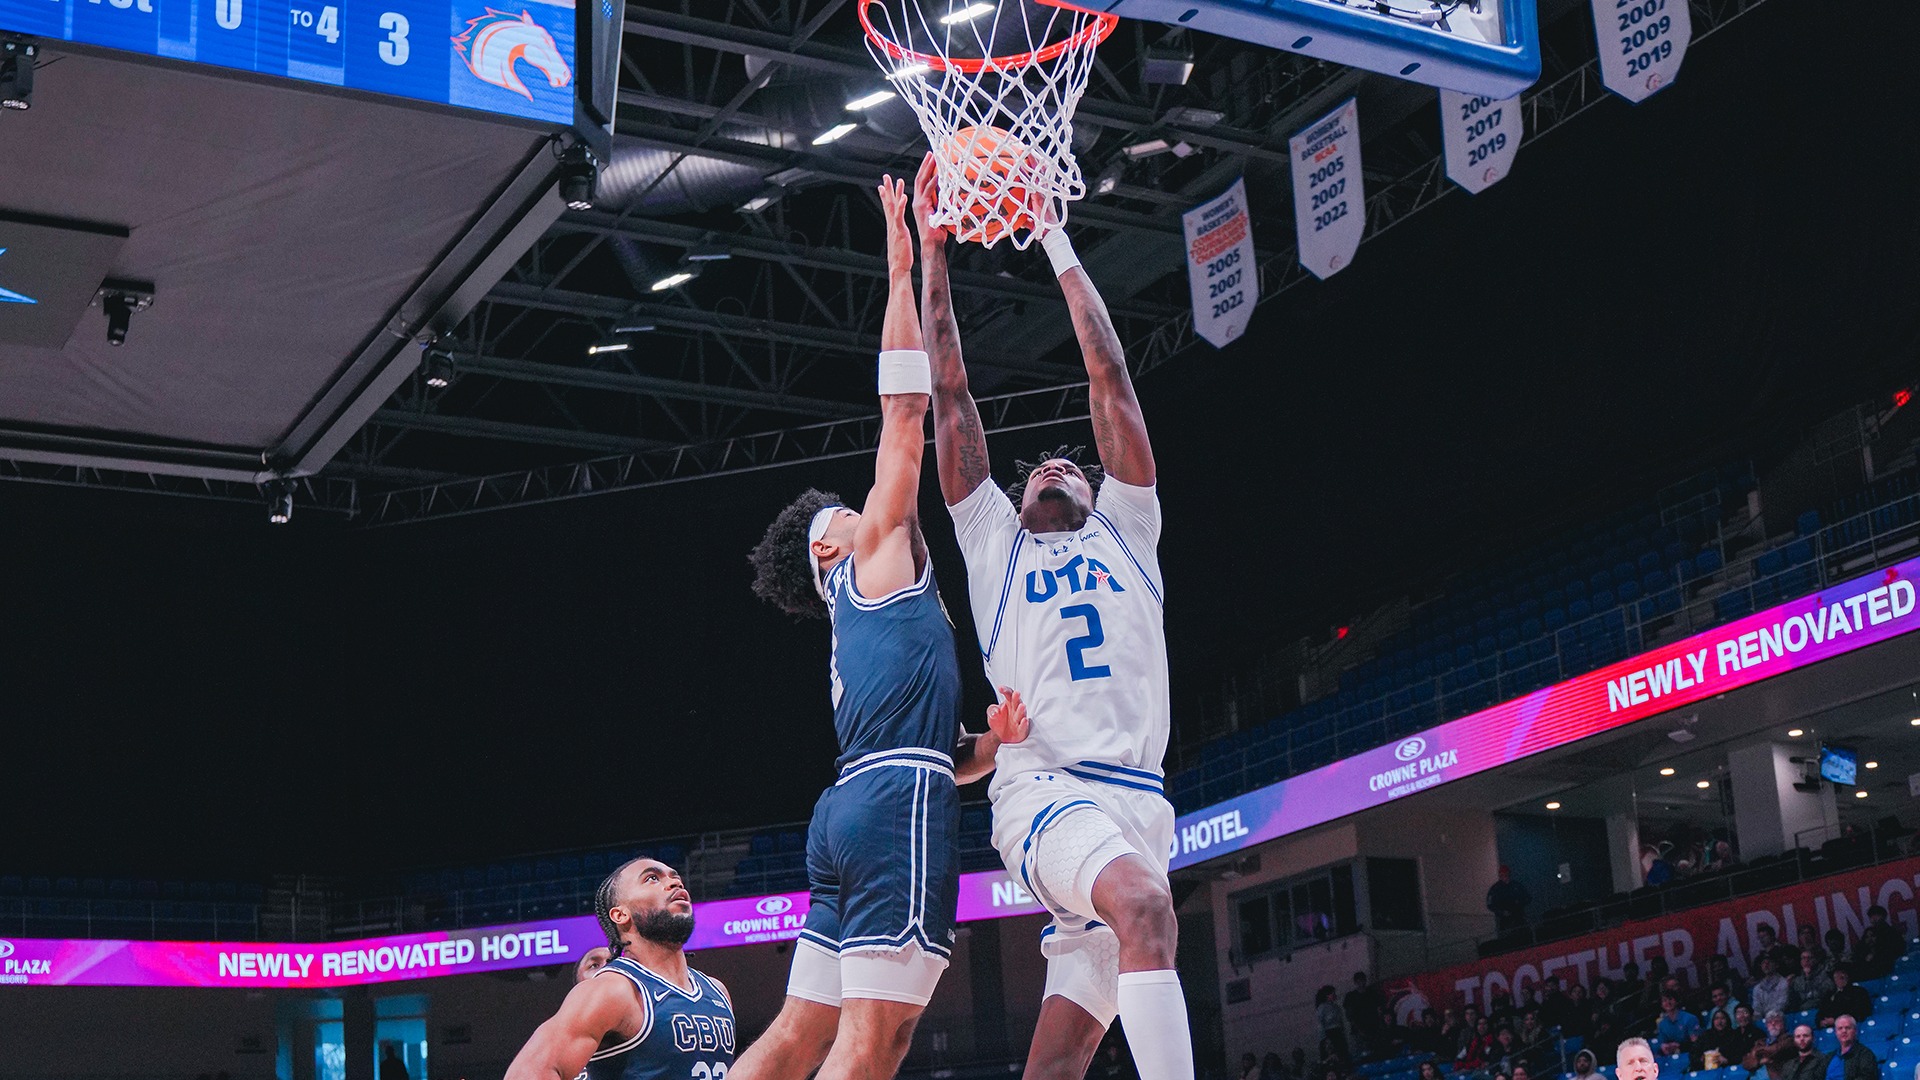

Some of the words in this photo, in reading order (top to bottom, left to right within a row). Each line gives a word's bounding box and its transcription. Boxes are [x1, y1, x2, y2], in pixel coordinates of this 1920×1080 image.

[290, 9, 313, 27] TO
[316, 5, 340, 44] 4
[378, 12, 410, 66] 3
[1621, 15, 1671, 55] 2009
[1627, 40, 1672, 78] 2019
[1461, 95, 1498, 121] 200
[1466, 108, 1502, 143] 2017
[1301, 125, 1348, 161] BASKETBALL
[1468, 133, 1506, 167] 2019
[1309, 156, 1344, 189] 2005
[1311, 178, 1346, 211] 2007
[1314, 201, 1348, 232] 2022
[1207, 247, 1240, 278] 2005
[1209, 268, 1242, 299] 2007
[1212, 290, 1244, 319] 2022
[1080, 531, 1100, 542] WAC
[1025, 554, 1126, 603] UTA
[1060, 603, 1112, 681] 2
[1606, 648, 1708, 713] NEWLY
[1715, 579, 1917, 676] RENOVATED
[1369, 762, 1418, 792] CROWNE
[1419, 749, 1458, 775] PLAZA
[1182, 809, 1249, 854] HOTEL
[723, 915, 780, 935] CROWNE
[5, 959, 52, 975] PLAZA
[219, 952, 315, 978] NEWLY
[322, 938, 475, 977] RENOVATED
[481, 929, 569, 962] HOTEL
[671, 1013, 736, 1055] CBU
